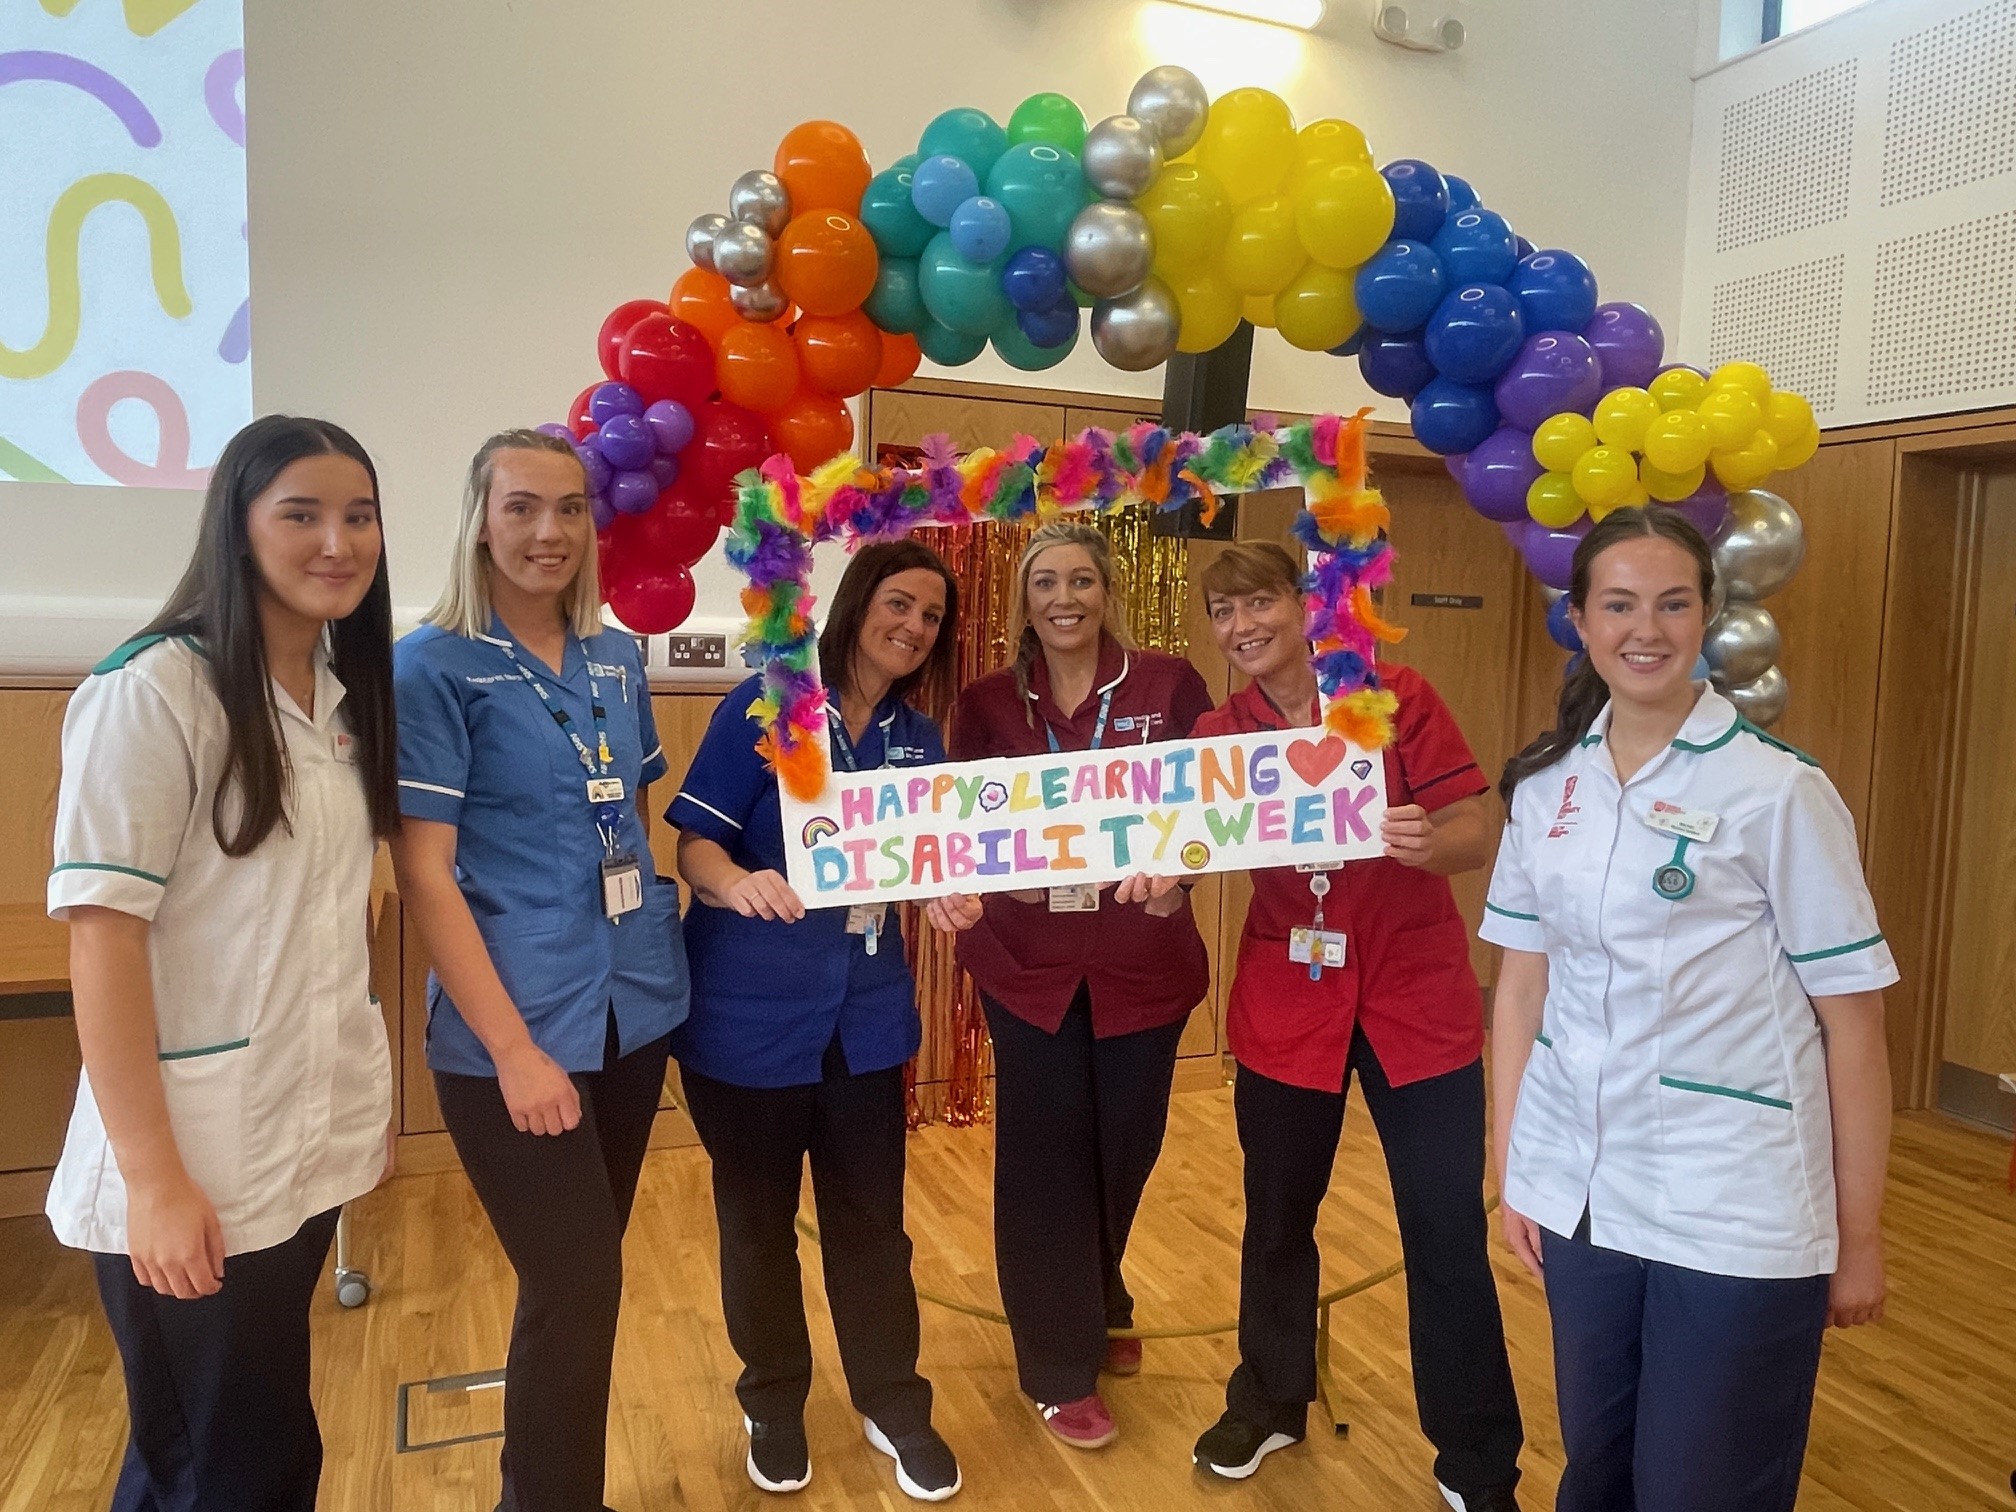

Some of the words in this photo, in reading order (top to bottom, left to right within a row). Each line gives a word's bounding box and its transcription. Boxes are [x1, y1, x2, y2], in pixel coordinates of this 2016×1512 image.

[841, 775, 984, 831] HAPPY
[1009, 744, 1280, 813] LEARNING
[813, 810, 1179, 892] DISABILITY
[1204, 785, 1378, 848] WEEK
